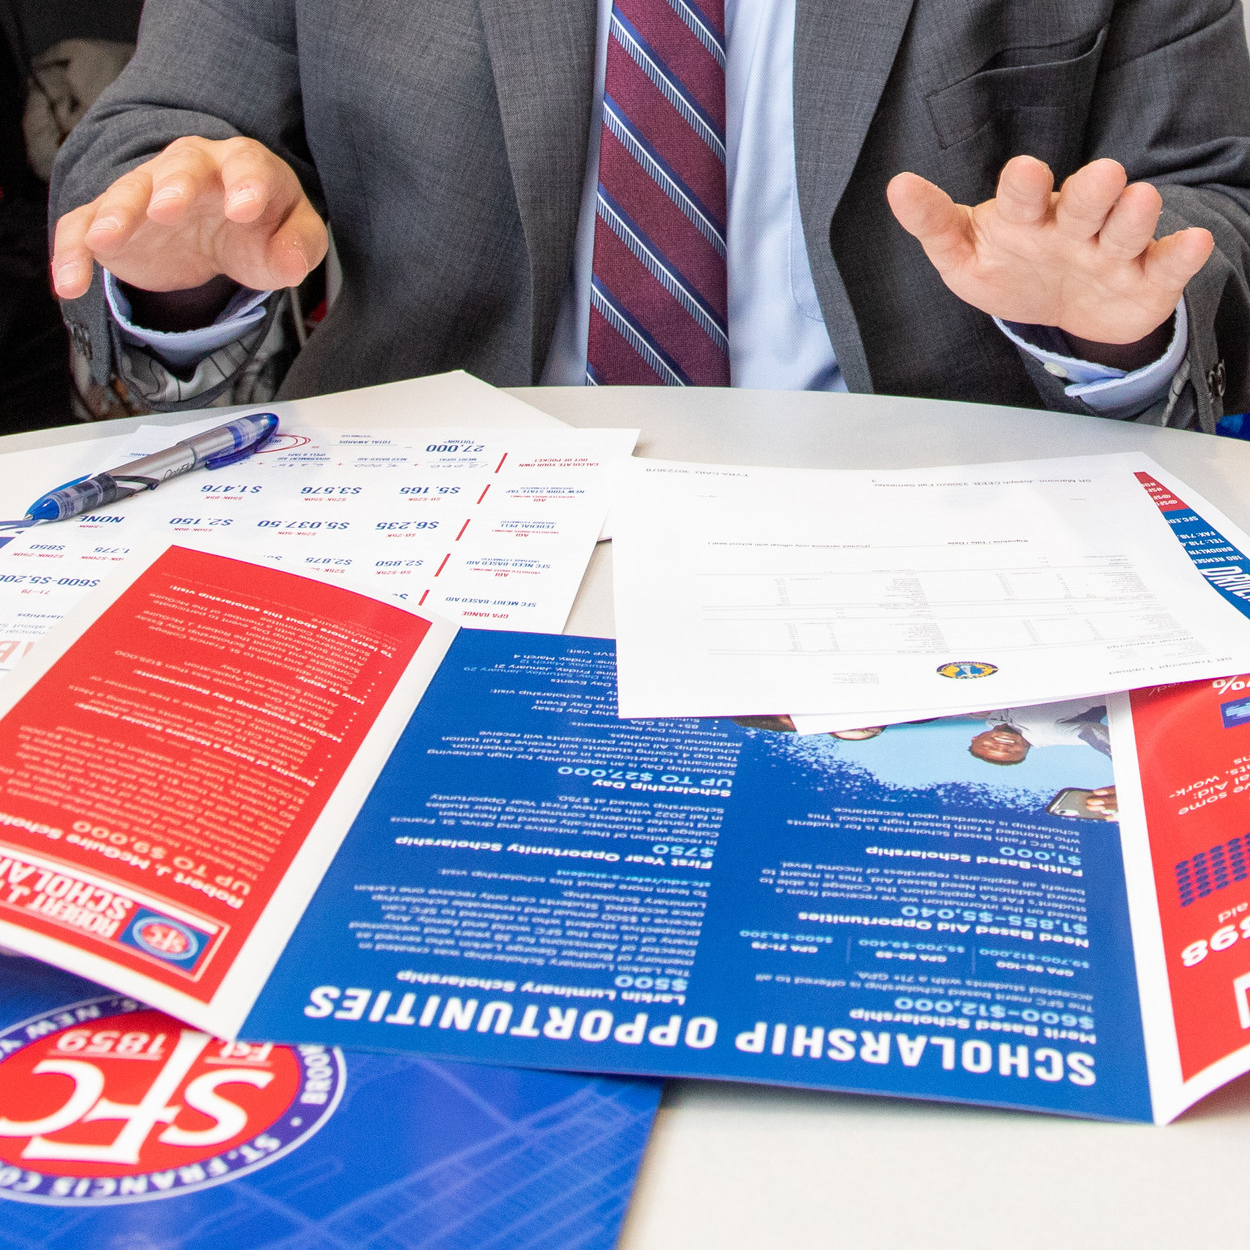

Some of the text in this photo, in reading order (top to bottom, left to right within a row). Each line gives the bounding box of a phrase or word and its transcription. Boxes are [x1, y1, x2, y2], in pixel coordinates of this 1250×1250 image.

[201, 485, 263, 494] $1,476
[301, 487, 362, 495] $3,576
[400, 487, 461, 495] $5,165
[76, 515, 125, 523] NONE
[169, 518, 234, 527] $2,150
[257, 521, 350, 530] $5,037.50
[376, 522, 440, 531] $6,235
[461, 598, 520, 607] MERIT-BASED
[170, 586, 392, 659] To learn more about this scholarship visit:
[461, 610, 490, 618] RANGE
[508, 664, 552, 672] January
[296, 676, 328, 689] apply:
[134, 670, 343, 743] McGuire Scholarship Day Requirements:
[342, 694, 365, 705] How
[566, 707, 588, 715] Day
[558, 767, 733, 788] UP TO $27,000
[592, 779, 732, 798] Scholarship Day
[1192, 782, 1228, 799] Aid:
[1178, 790, 1228, 815] some
[66, 835, 151, 870] McGuire
[73, 821, 251, 896] UP TO $9,000
[395, 837, 713, 870] First Year Opportunity Scholarship
[653, 845, 715, 859] $750
[1000, 847, 1081, 867] $1,000
[156, 866, 172, 877] J.
[866, 847, 1083, 878] Faith-Based Scholarship
[174, 873, 244, 909] Robert
[6, 883, 120, 938] ROBERT J.
[1218, 902, 1248, 924] aid
[799, 912, 1090, 949] Need Based Aid Opportunities
[614, 975, 688, 993] $500
[858, 972, 890, 982] GPA.
[894, 975, 914, 983] 71+
[397, 971, 686, 1006] Larkin Luminary Scholarship
[966, 980, 1026, 993] students
[1029, 987, 1094, 1001] accepted
[24, 1004, 100, 1040] NEW
[850, 1009, 1097, 1045] Merit Based Scholarship
[56, 1028, 166, 1056] 1859
[302, 984, 1098, 1088] SCHOLARSHIP OPPORTUNITIES
[0, 1029, 276, 1166] SFC
[49, 1133, 281, 1198] ST. FRANCIS
